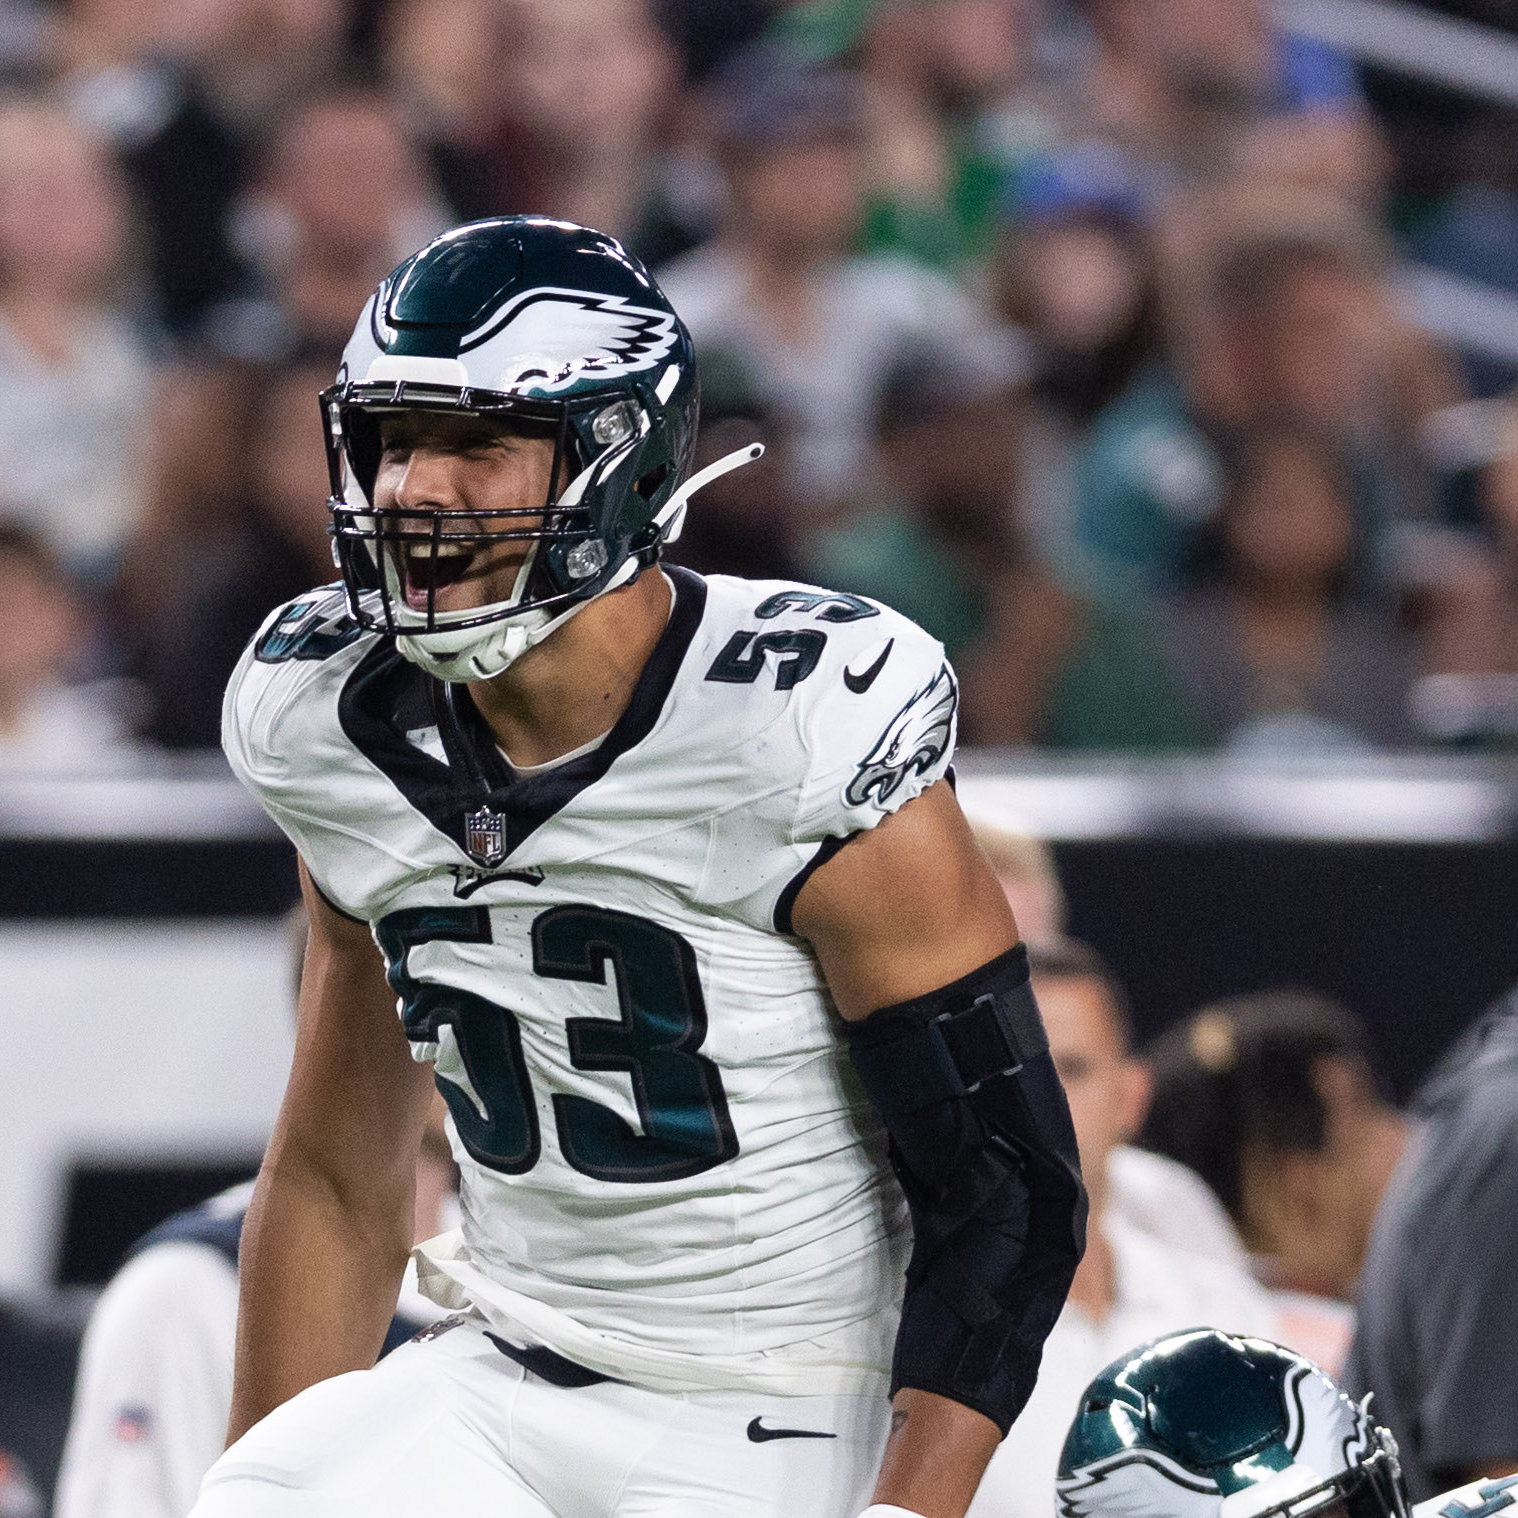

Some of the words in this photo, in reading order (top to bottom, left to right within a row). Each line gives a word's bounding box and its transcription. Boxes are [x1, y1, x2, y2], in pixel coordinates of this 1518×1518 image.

[704, 591, 881, 690] 53
[471, 831, 501, 855] NFL
[375, 903, 740, 1184] 53
